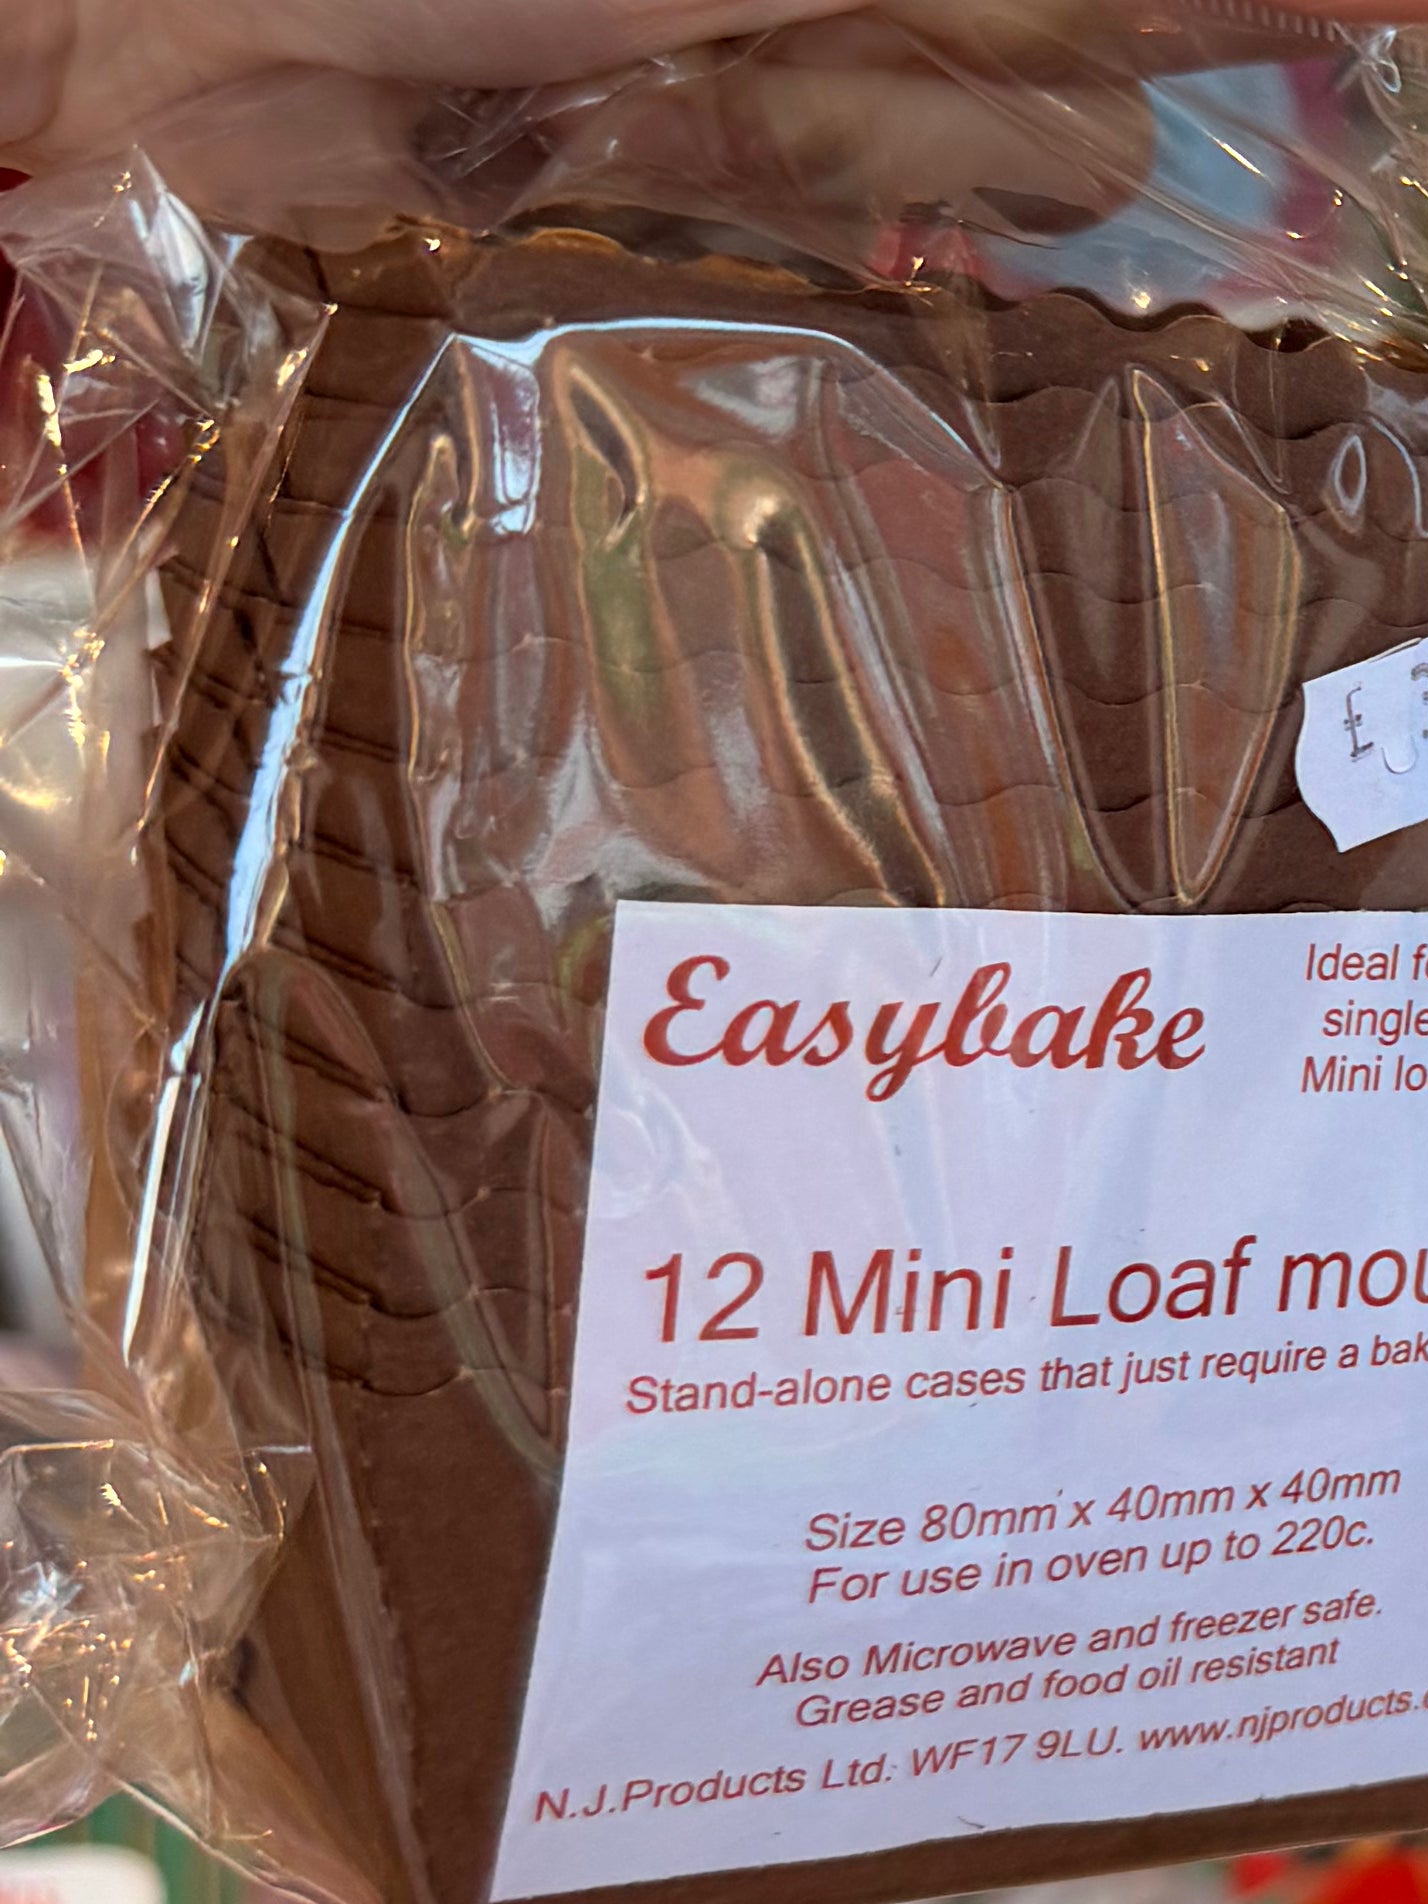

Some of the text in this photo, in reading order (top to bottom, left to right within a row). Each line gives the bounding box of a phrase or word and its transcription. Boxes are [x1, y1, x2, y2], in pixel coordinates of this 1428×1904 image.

[1305, 944, 1399, 982] Ideal
[639, 953, 1205, 1104] Easybake
[1301, 1056, 1380, 1093] Mini
[642, 1252, 764, 1344] 12
[801, 1246, 1014, 1338] Mini
[1049, 1235, 1257, 1328] Loaf
[624, 1368, 892, 1416] Stand-alone
[904, 1368, 1025, 1400] cases
[1039, 1358, 1112, 1392] that
[1117, 1352, 1189, 1395] just
[1200, 1347, 1326, 1384] require
[1337, 1344, 1359, 1369] a
[805, 1468, 1400, 1552] Size 80mm x 40mm x 40mm
[808, 1516, 1372, 1604] For use in oven up to 220c.
[755, 1589, 1382, 1687] Also Microwave and freezer safe.
[795, 1639, 1338, 1728] Grease and food oil resistant
[820, 1753, 893, 1791] Ltd.
[911, 1732, 1027, 1777] WF17
[1036, 1726, 1124, 1760] 9LU.
